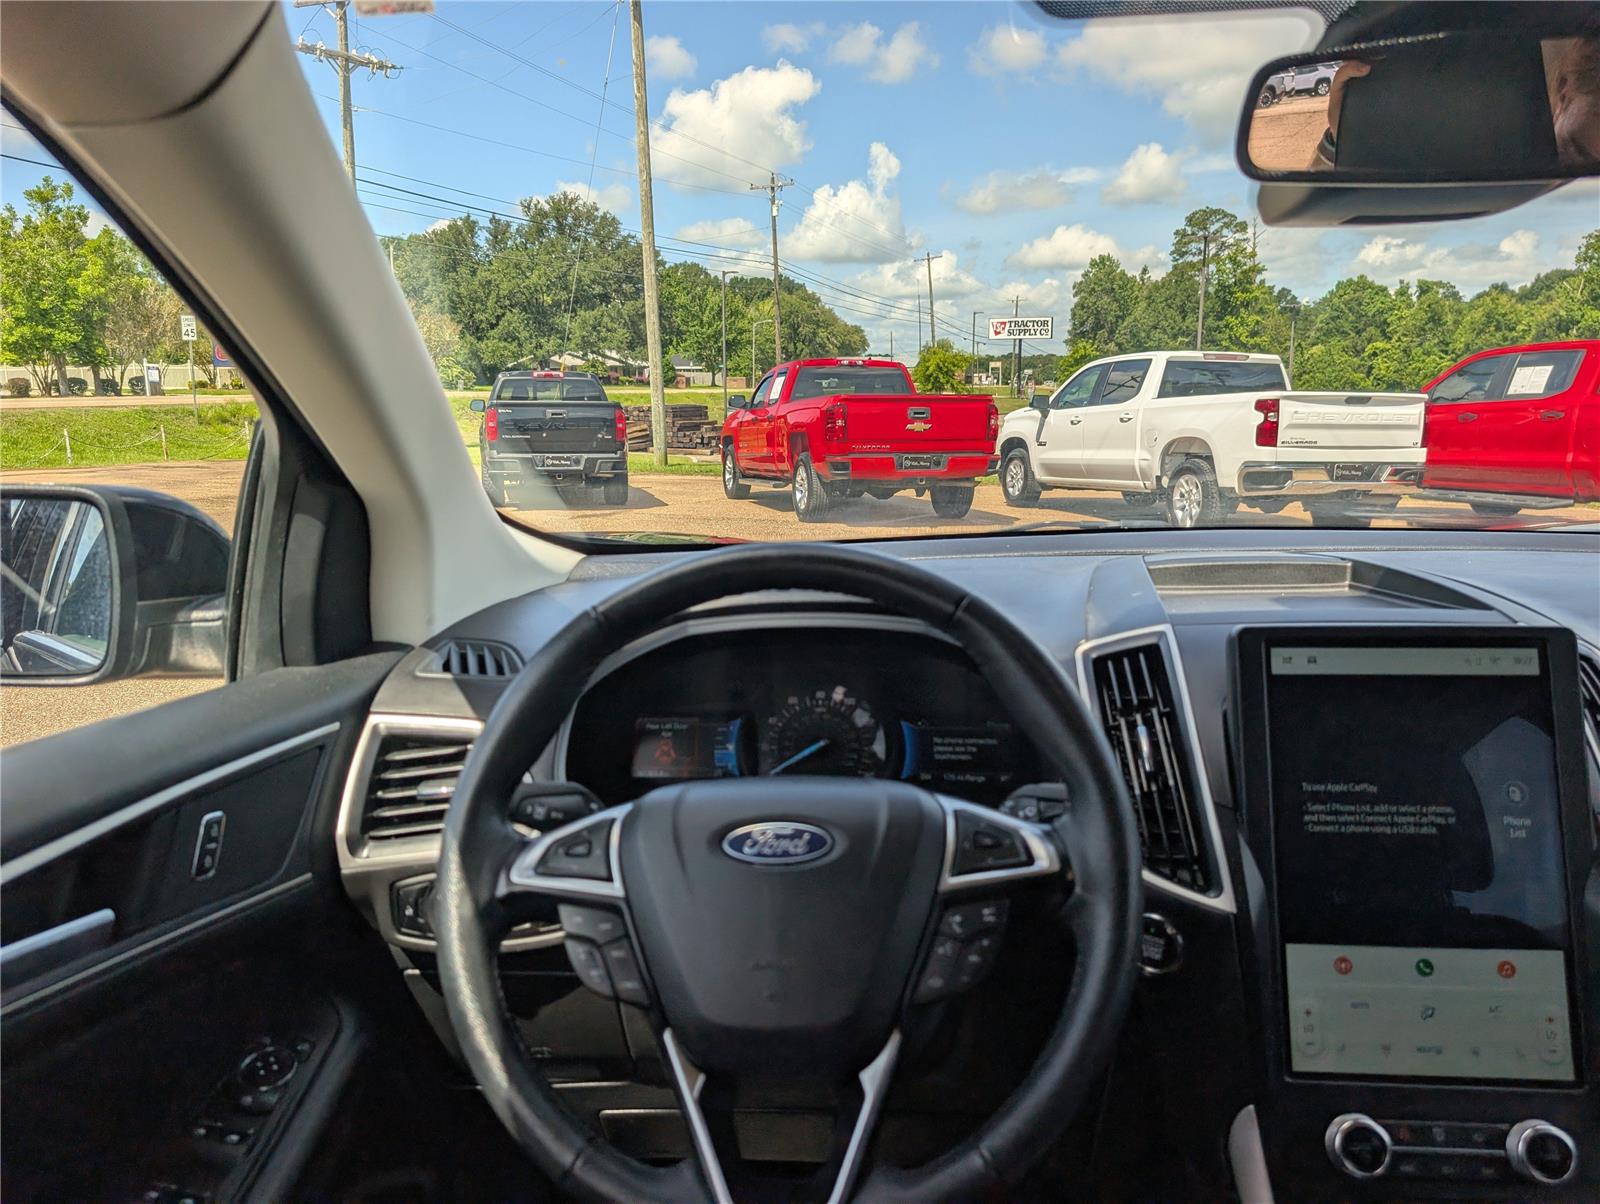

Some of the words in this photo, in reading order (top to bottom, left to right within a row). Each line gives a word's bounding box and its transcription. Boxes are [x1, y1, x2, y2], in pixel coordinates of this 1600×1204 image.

[1007, 319, 1049, 328] TRACTOR
[183, 328, 195, 338] 45
[1007, 328, 1038, 337] SUPPLY
[1327, 783, 1348, 793] Apple
[1503, 815, 1532, 827] Phone
[742, 828, 812, 856] Ford
